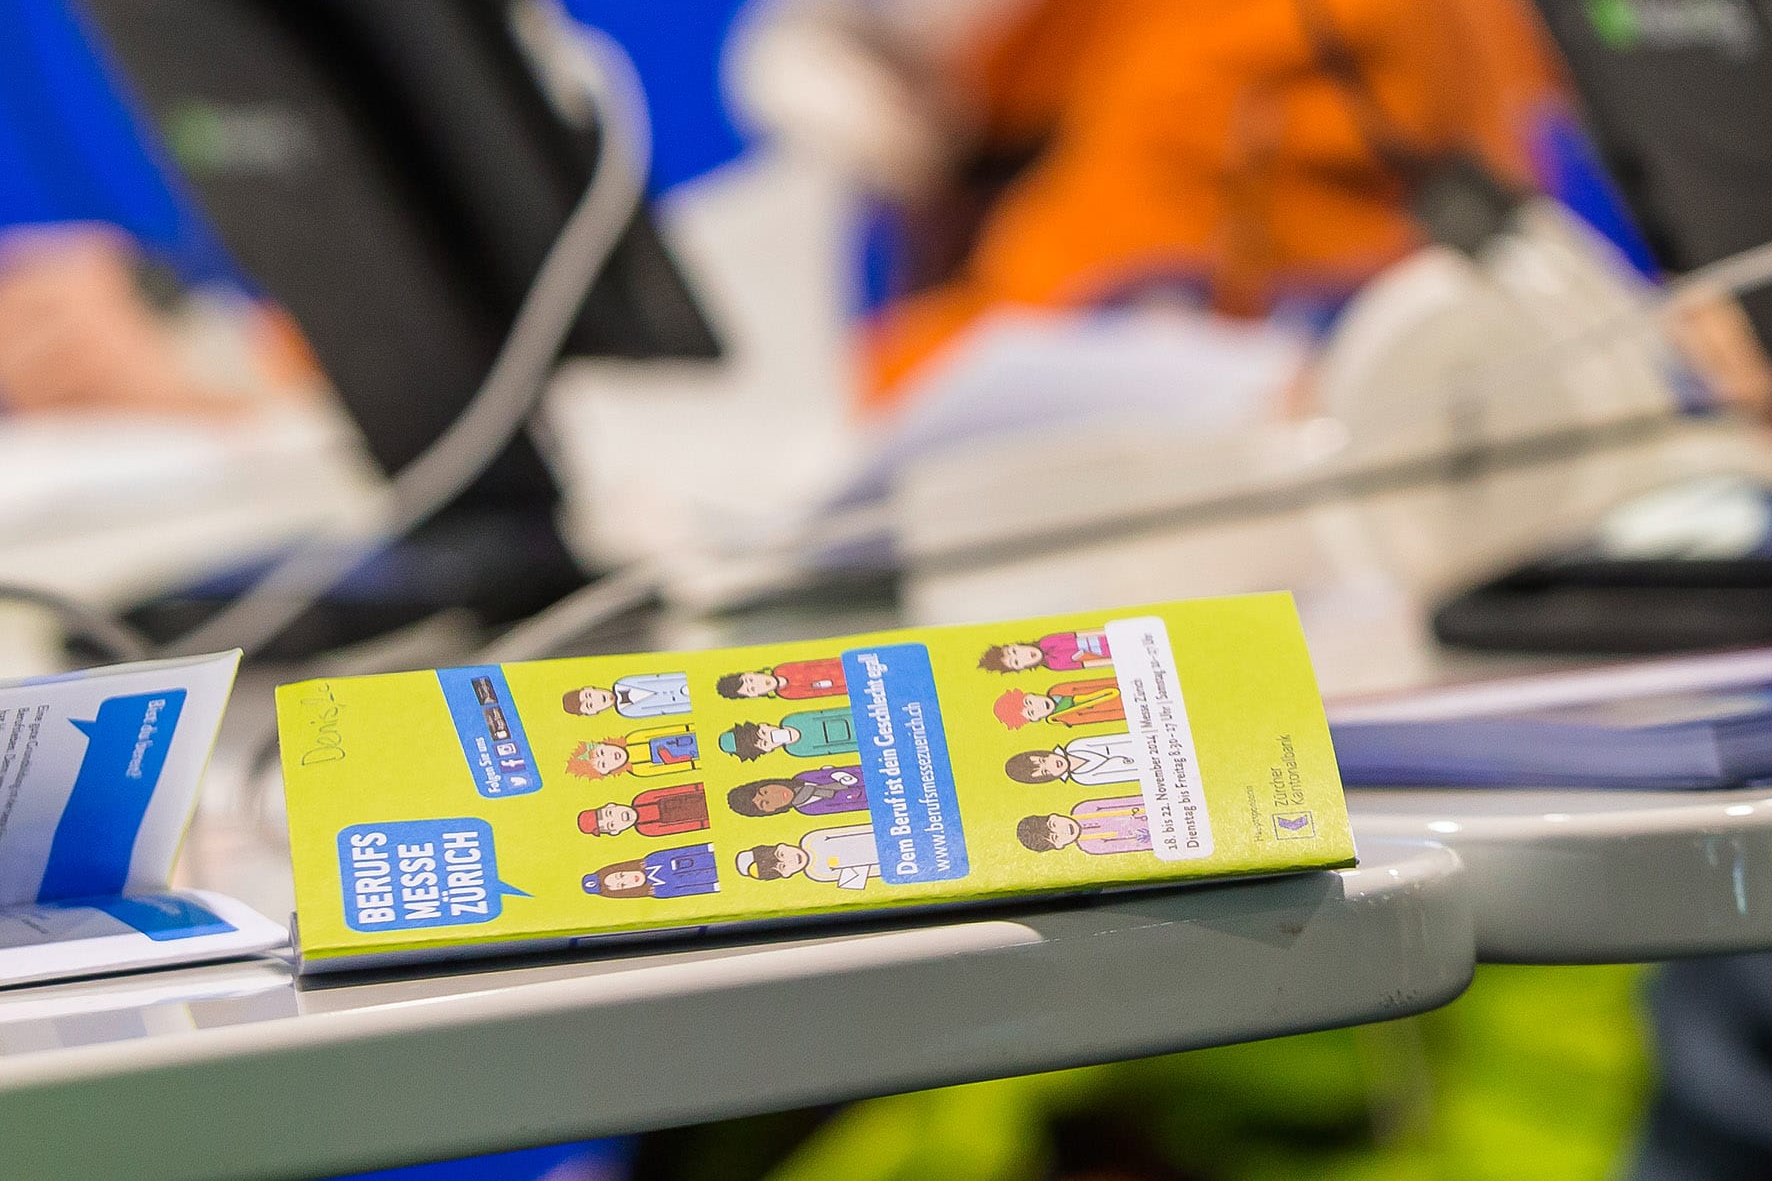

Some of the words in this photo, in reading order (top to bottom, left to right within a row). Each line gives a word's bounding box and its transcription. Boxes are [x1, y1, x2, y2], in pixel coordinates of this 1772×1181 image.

[1130, 679, 1147, 703] Zürich
[1150, 670, 1169, 699] Samstag
[863, 679, 895, 746] Geschlecht
[1137, 704, 1152, 728] Messe
[1159, 706, 1173, 721] Uhr
[475, 737, 488, 752] uns
[478, 753, 492, 766] Sie
[878, 748, 901, 776] dein
[1168, 758, 1188, 788] Freitag
[1276, 734, 1304, 805] Kantonalbank
[884, 778, 905, 795] ist
[901, 702, 950, 871] www.berufsmessezuerich.ch
[1149, 757, 1167, 801] November
[1269, 767, 1288, 807] Zürcher
[1175, 790, 1191, 804] bis
[885, 797, 912, 835] Beruf
[1160, 819, 1174, 833] bis
[1180, 806, 1200, 848] Dienstag
[895, 839, 918, 874] Dem
[1166, 835, 1178, 850] 18.
[352, 831, 396, 924] BERUFS
[397, 842, 443, 920] MESSE
[441, 831, 489, 916] ZÜRICH
